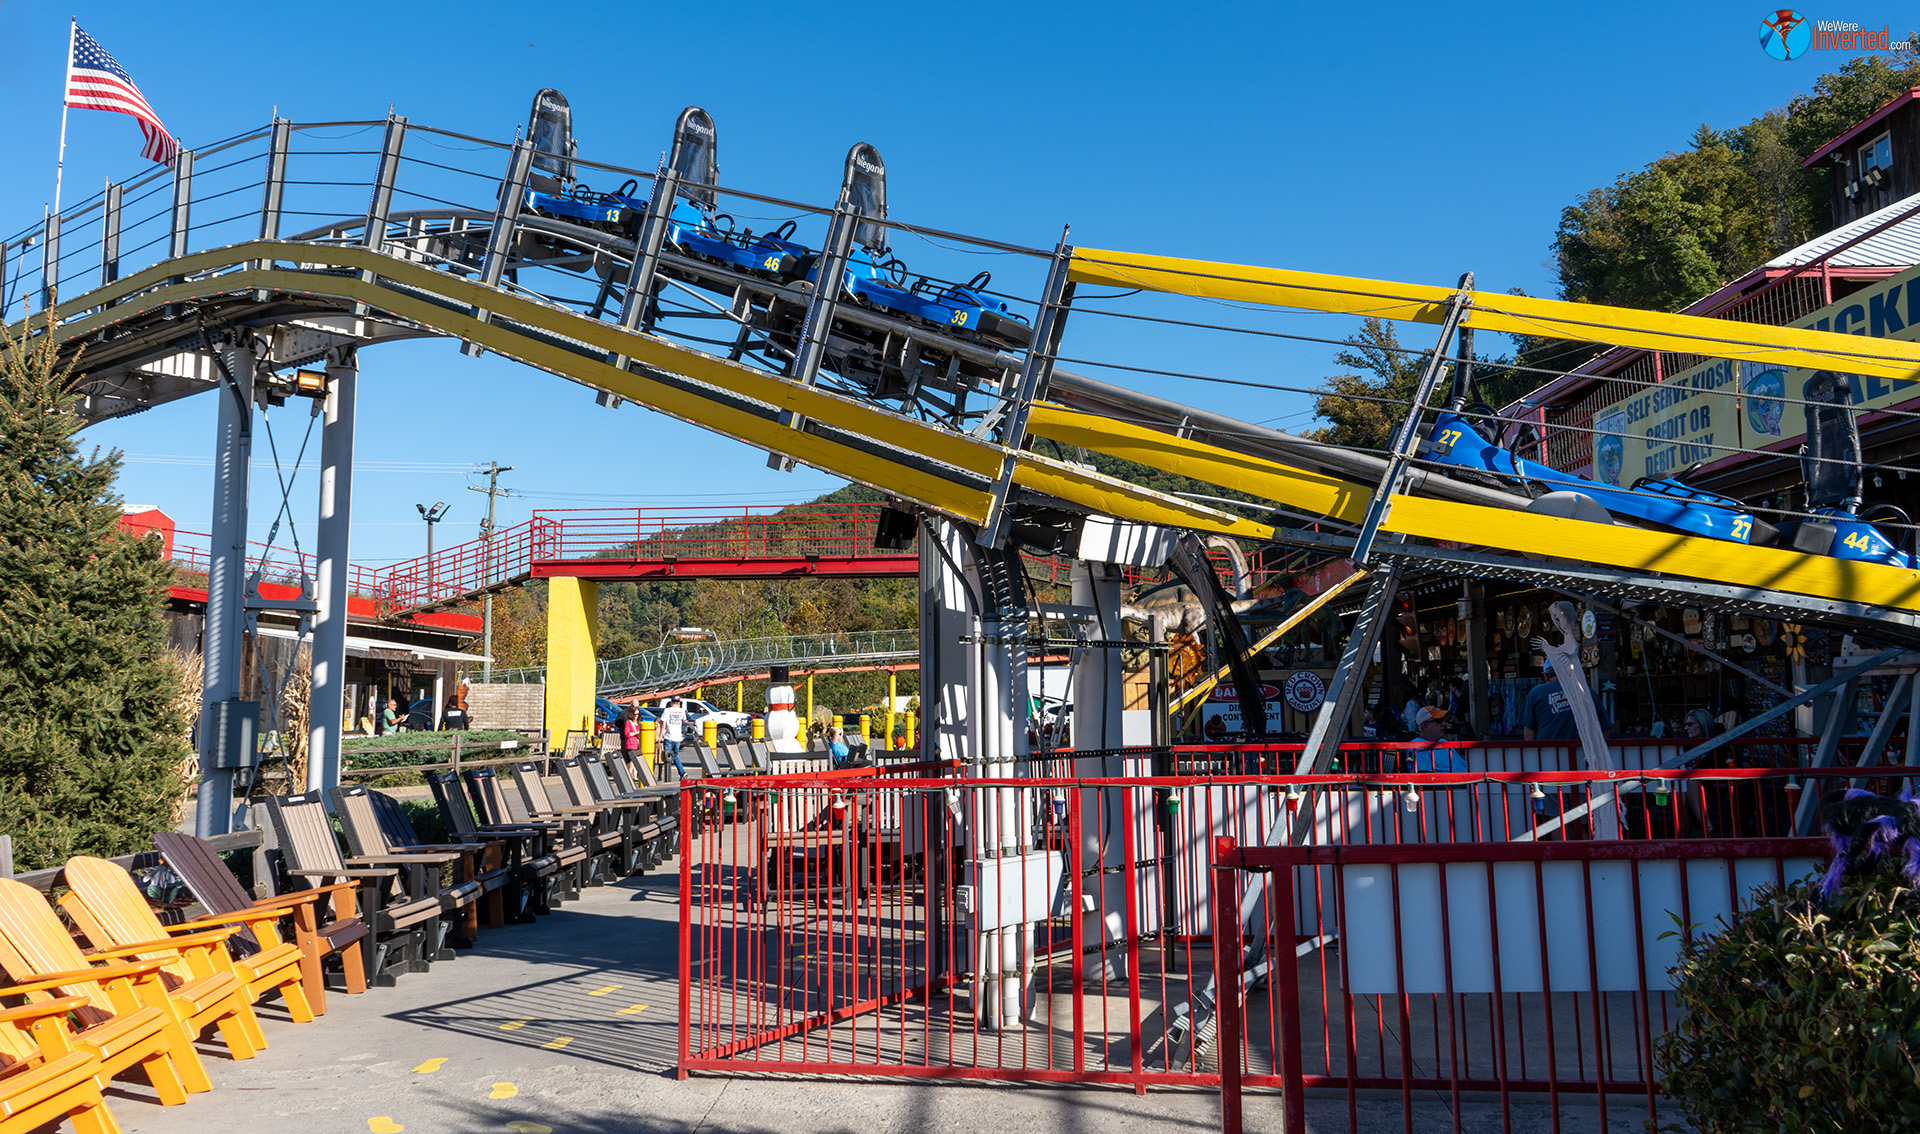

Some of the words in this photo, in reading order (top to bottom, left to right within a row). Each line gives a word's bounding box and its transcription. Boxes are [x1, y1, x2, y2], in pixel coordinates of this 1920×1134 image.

[606, 209, 620, 222] 13
[764, 256, 780, 271] 46
[951, 309, 968, 325] 39
[1627, 394, 1651, 425] SELF
[1653, 378, 1689, 414] SERVE
[1691, 358, 1734, 398] KIOSK
[1438, 429, 1462, 447] 27
[1645, 412, 1687, 450] CREDIT
[1690, 405, 1711, 433] OR
[1645, 445, 1677, 478] DEBIT
[1680, 432, 1714, 466] ONLY
[1730, 519, 1752, 540] 27
[1843, 531, 1870, 552] 44
[1286, 677, 1297, 694] RED
[1297, 672, 1324, 695] CROWN
[1288, 697, 1322, 711] GASOLINE
